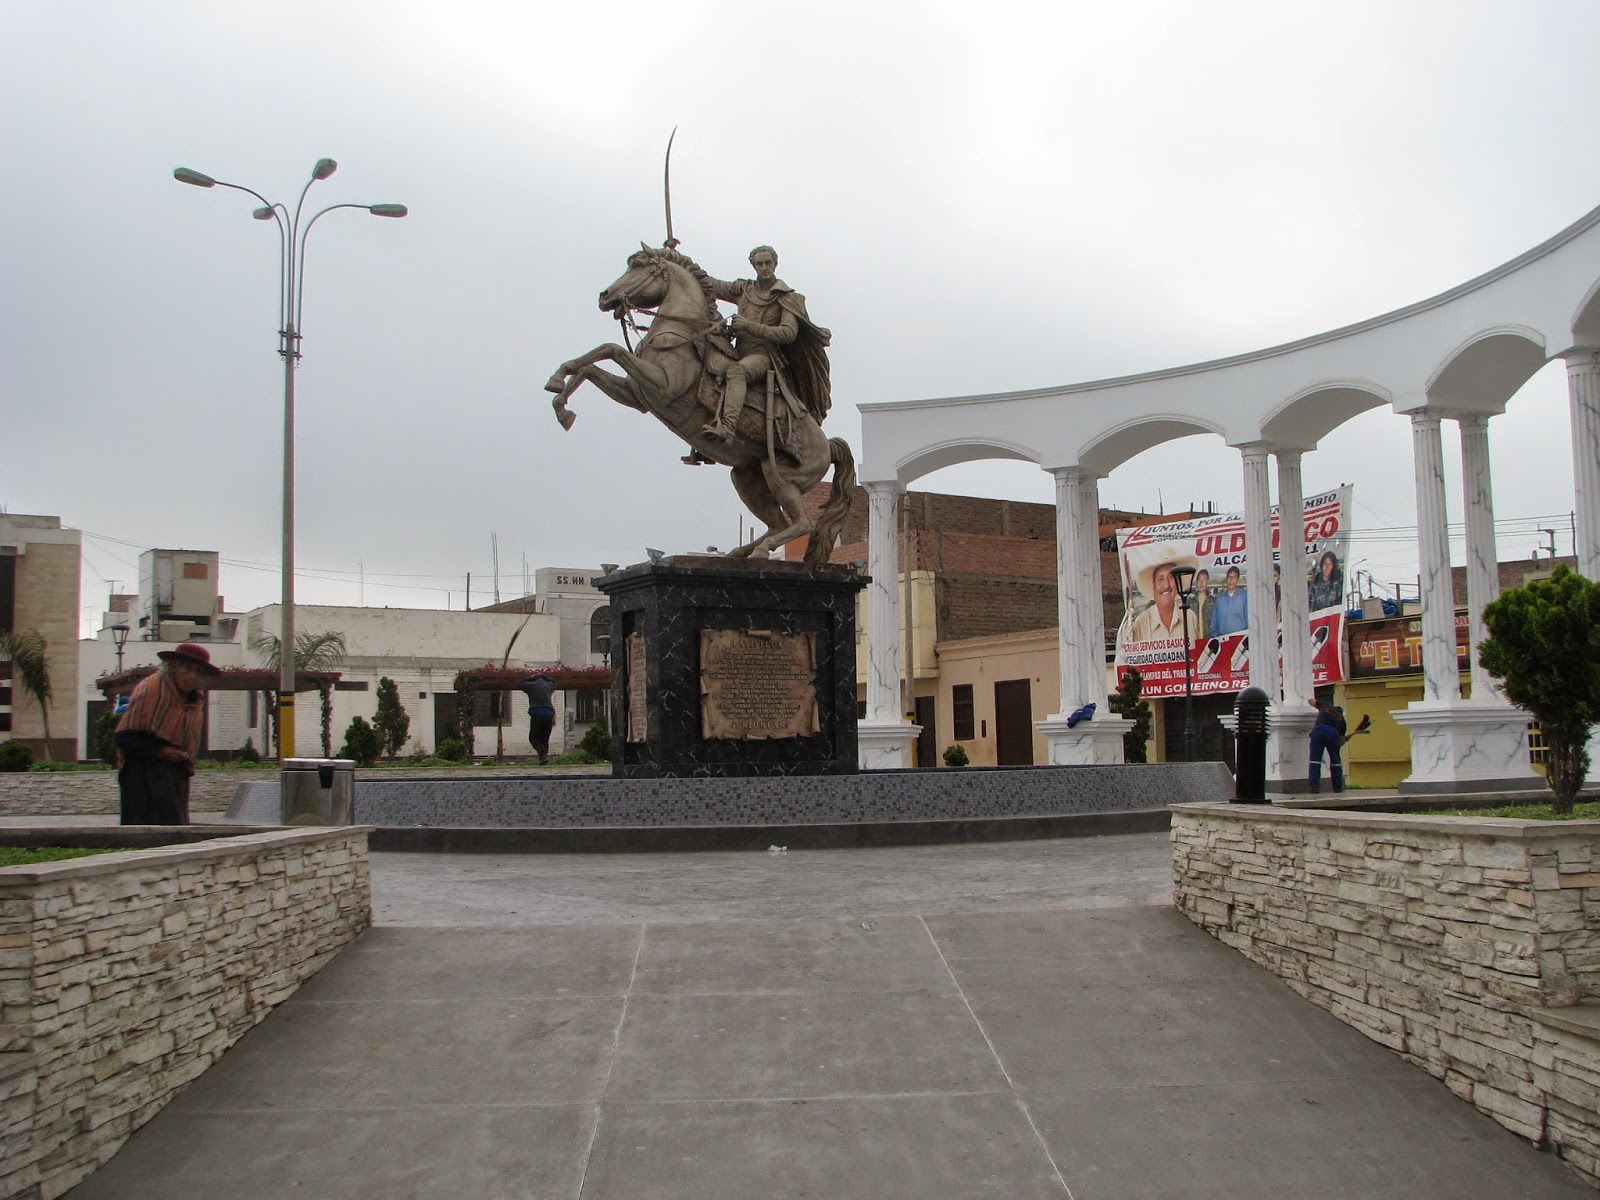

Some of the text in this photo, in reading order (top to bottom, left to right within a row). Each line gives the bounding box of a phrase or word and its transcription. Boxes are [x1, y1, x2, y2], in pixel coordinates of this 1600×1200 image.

[1145, 522, 1194, 534] JUNTOS,
[1198, 517, 1222, 527] POR
[1304, 493, 1337, 509] MBIO
[1195, 516, 1339, 557] ULDICO
[1214, 551, 1281, 567] ALCAE
[556, 576, 587, 586] SS.HH.
[1139, 640, 1166, 652] SERVICIOS
[1166, 637, 1191, 649] BASICS
[1153, 651, 1188, 662] CIUDADAN
[1146, 685, 1162, 694] UN
